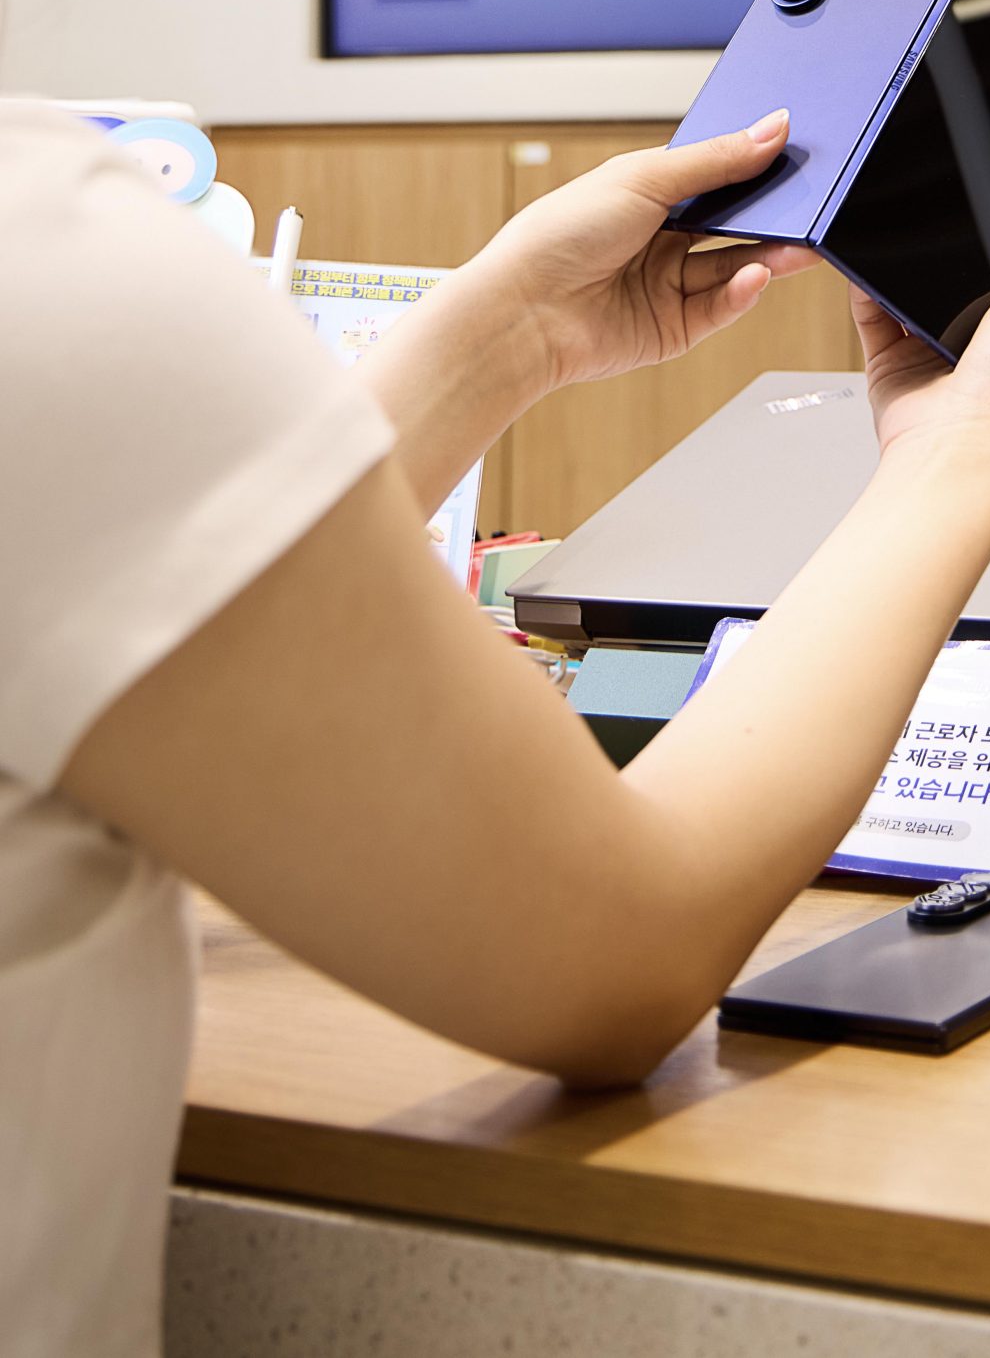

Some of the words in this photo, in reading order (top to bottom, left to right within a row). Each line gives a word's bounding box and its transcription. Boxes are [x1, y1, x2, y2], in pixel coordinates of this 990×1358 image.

[891, 50, 918, 91] SAMSUNG
[915, 721, 979, 743] 근로자
[905, 748, 968, 770] 제공을
[865, 816, 902, 831] 구하고
[904, 820, 955, 836] 있습니다.
